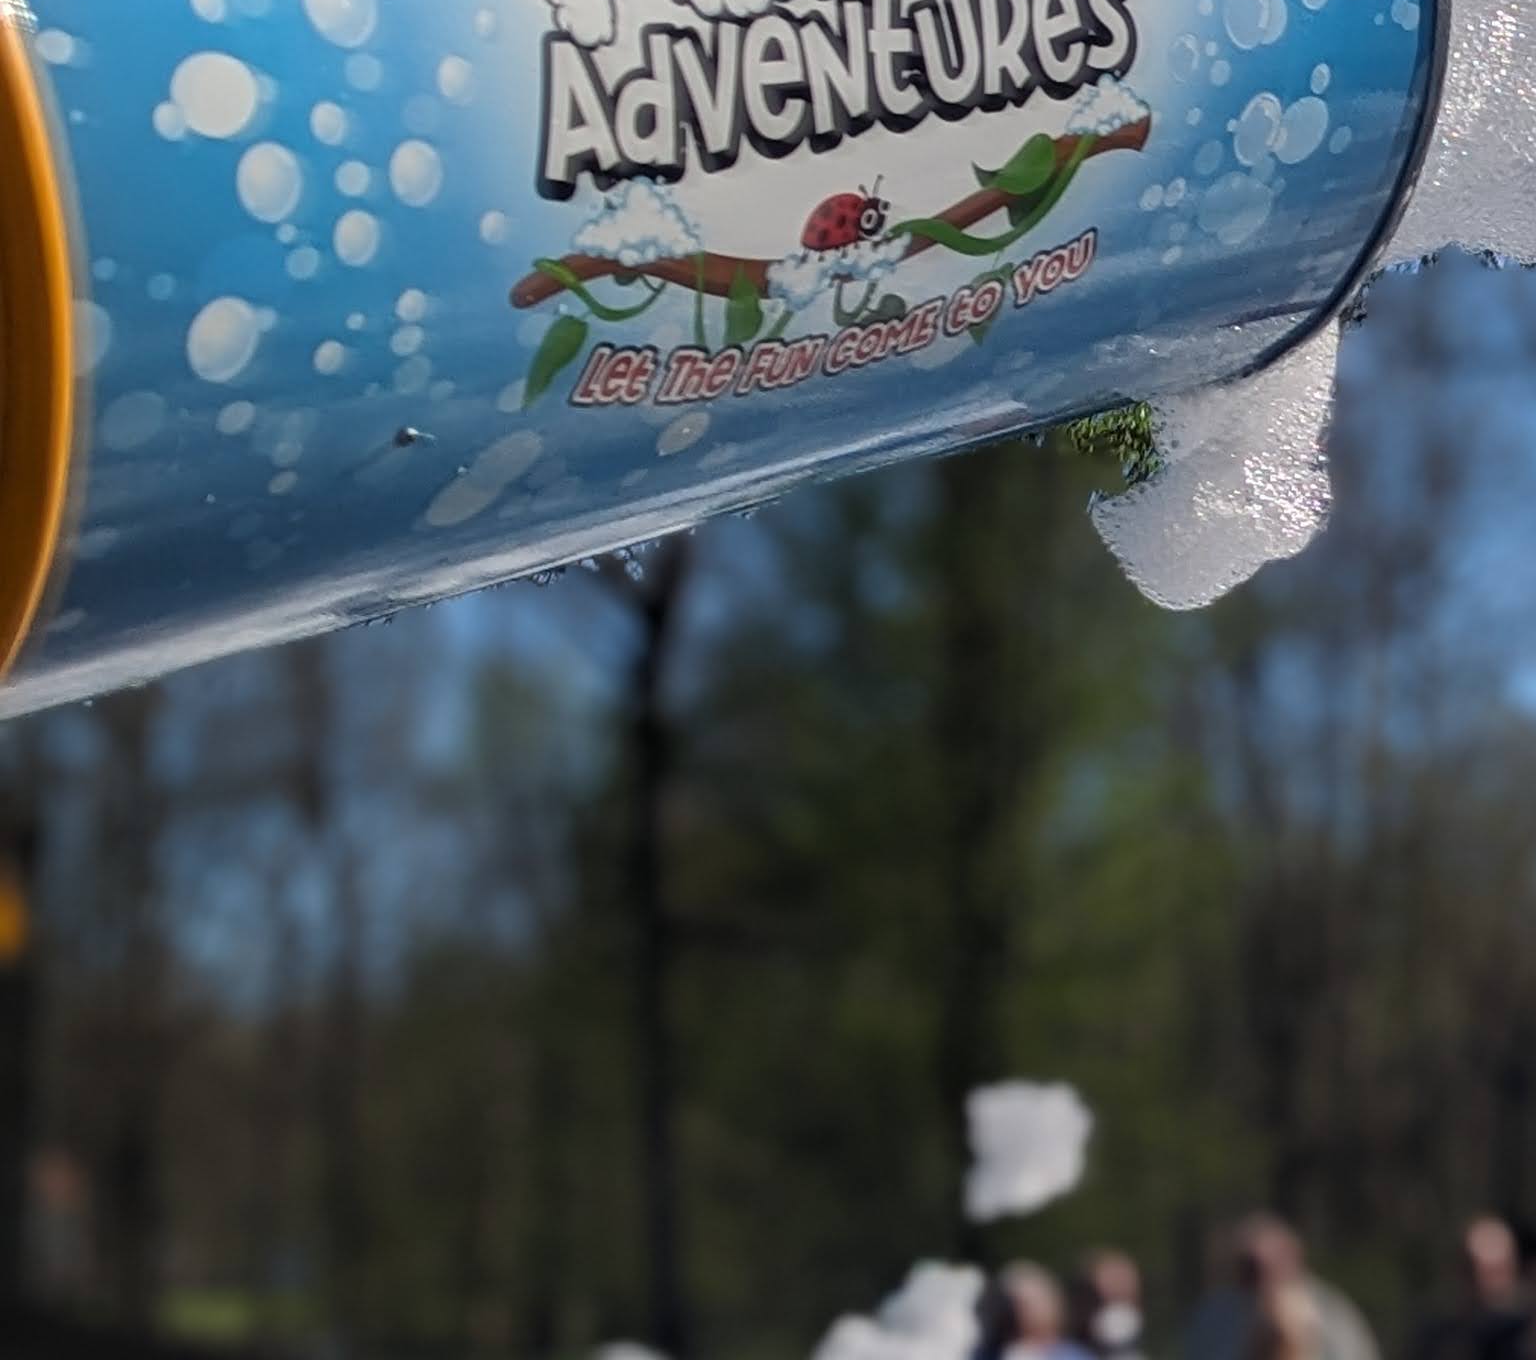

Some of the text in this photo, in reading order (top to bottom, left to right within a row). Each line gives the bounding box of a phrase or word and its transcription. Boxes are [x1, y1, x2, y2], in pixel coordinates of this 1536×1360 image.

[572, 343, 655, 406] Let
[656, 337, 742, 406] The
[736, 333, 826, 395] FUN
[823, 295, 946, 375] COME
[1011, 228, 1098, 309] YOU
